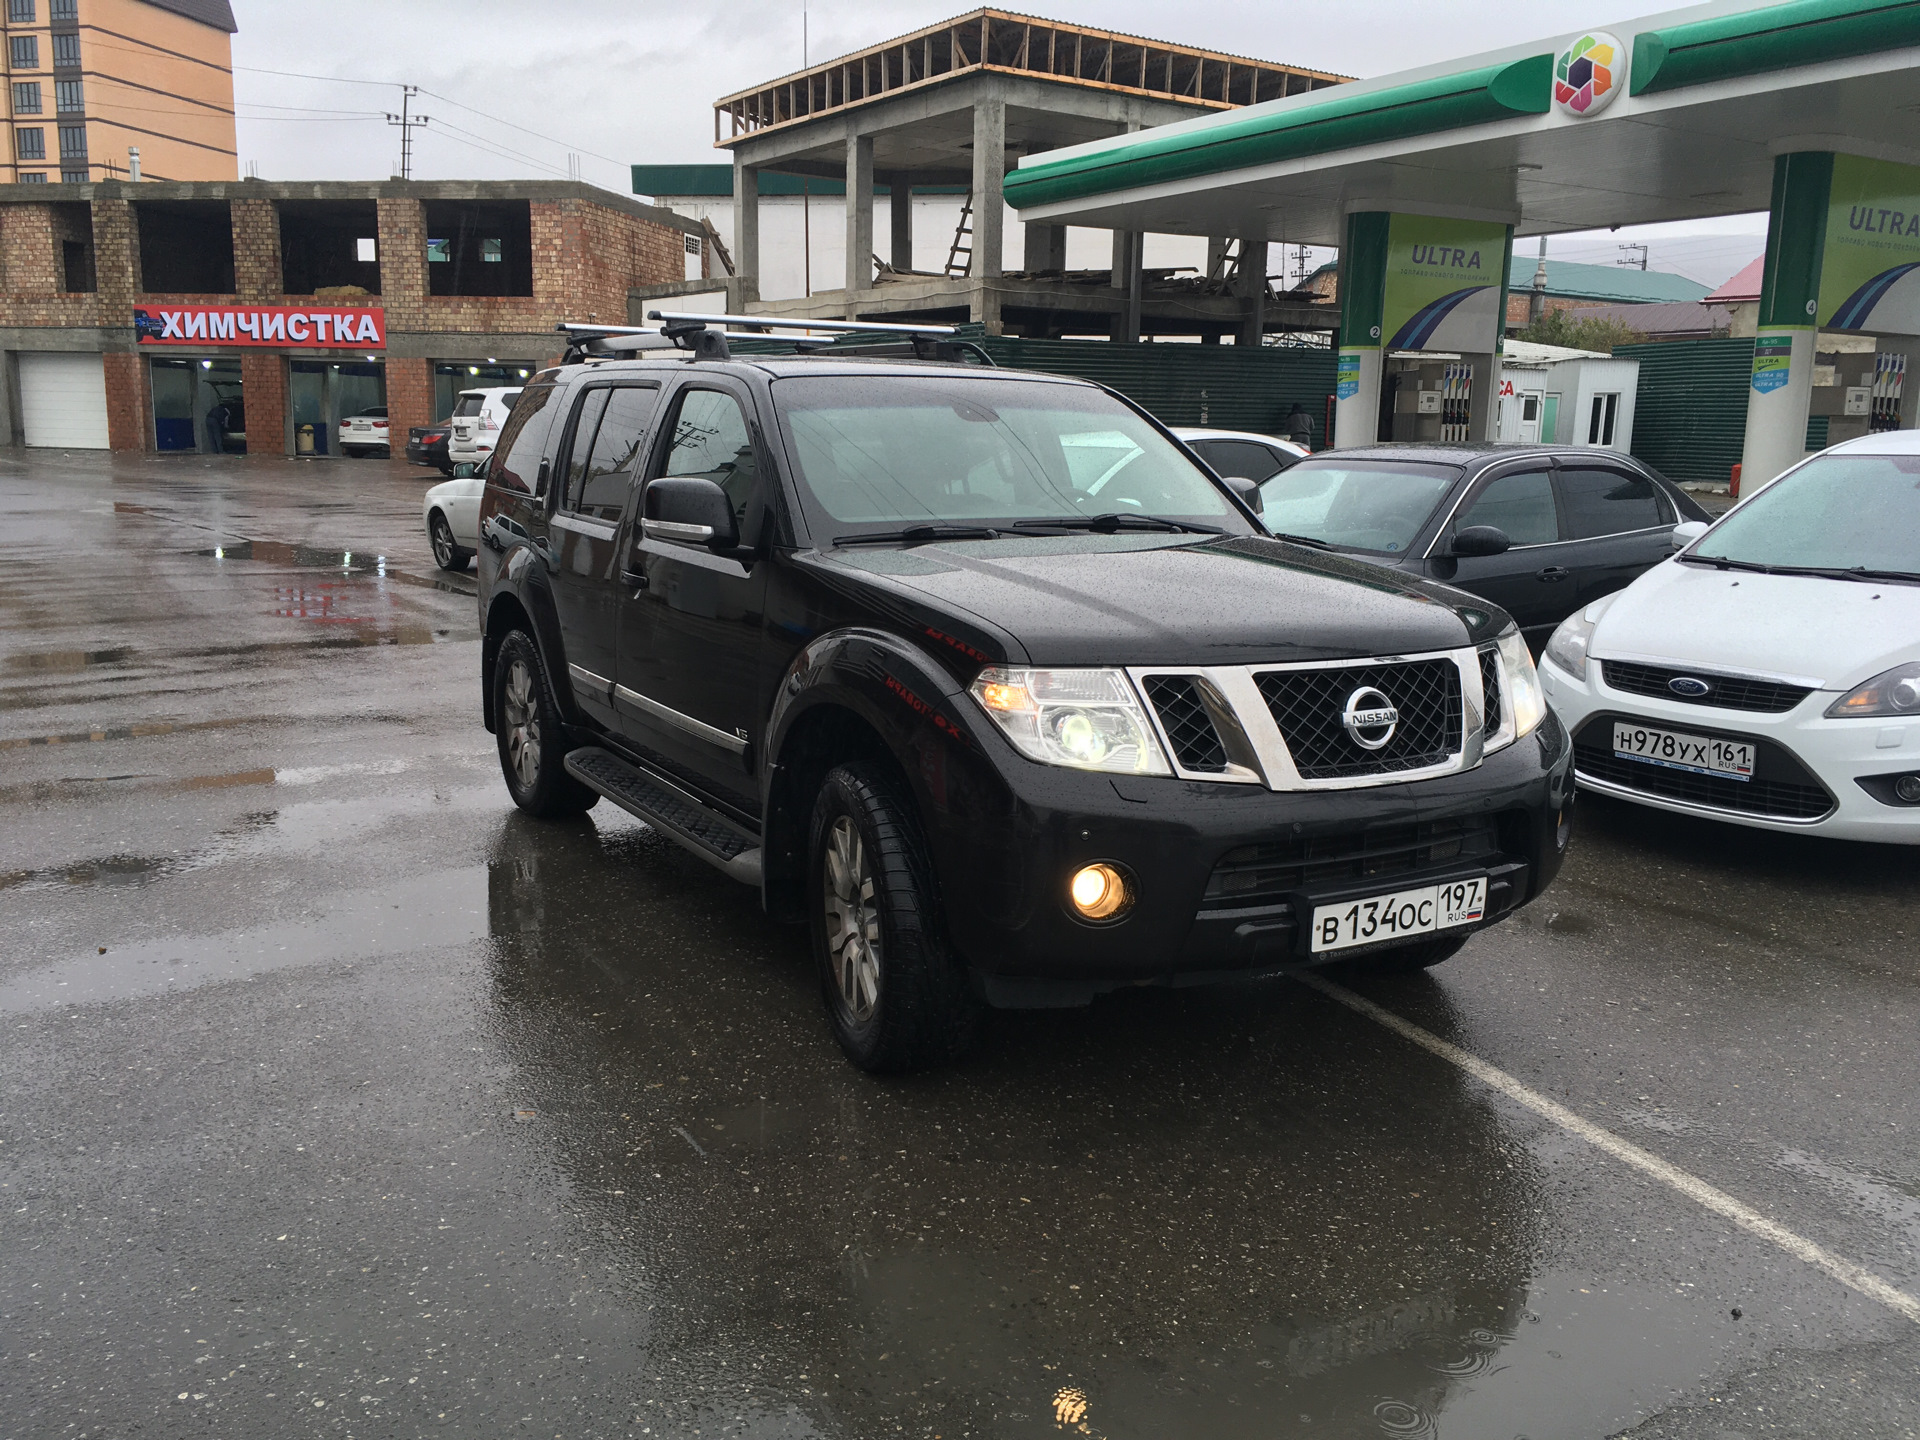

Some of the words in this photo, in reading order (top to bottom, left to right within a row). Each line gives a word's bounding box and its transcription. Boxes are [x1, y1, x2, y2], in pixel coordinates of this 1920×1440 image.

[1849, 206, 1920, 237] ULTRA
[1411, 244, 1481, 269] ULTRA
[1808, 302, 1815, 313] 4
[159, 311, 381, 343] ХИМЧИСТКА
[1372, 327, 1379, 337] 2
[1352, 711, 1397, 725] NISSAN
[1712, 742, 1748, 764] 161
[1718, 761, 1737, 770] RUS
[1440, 881, 1479, 912] 197
[1447, 911, 1467, 923] RUS
